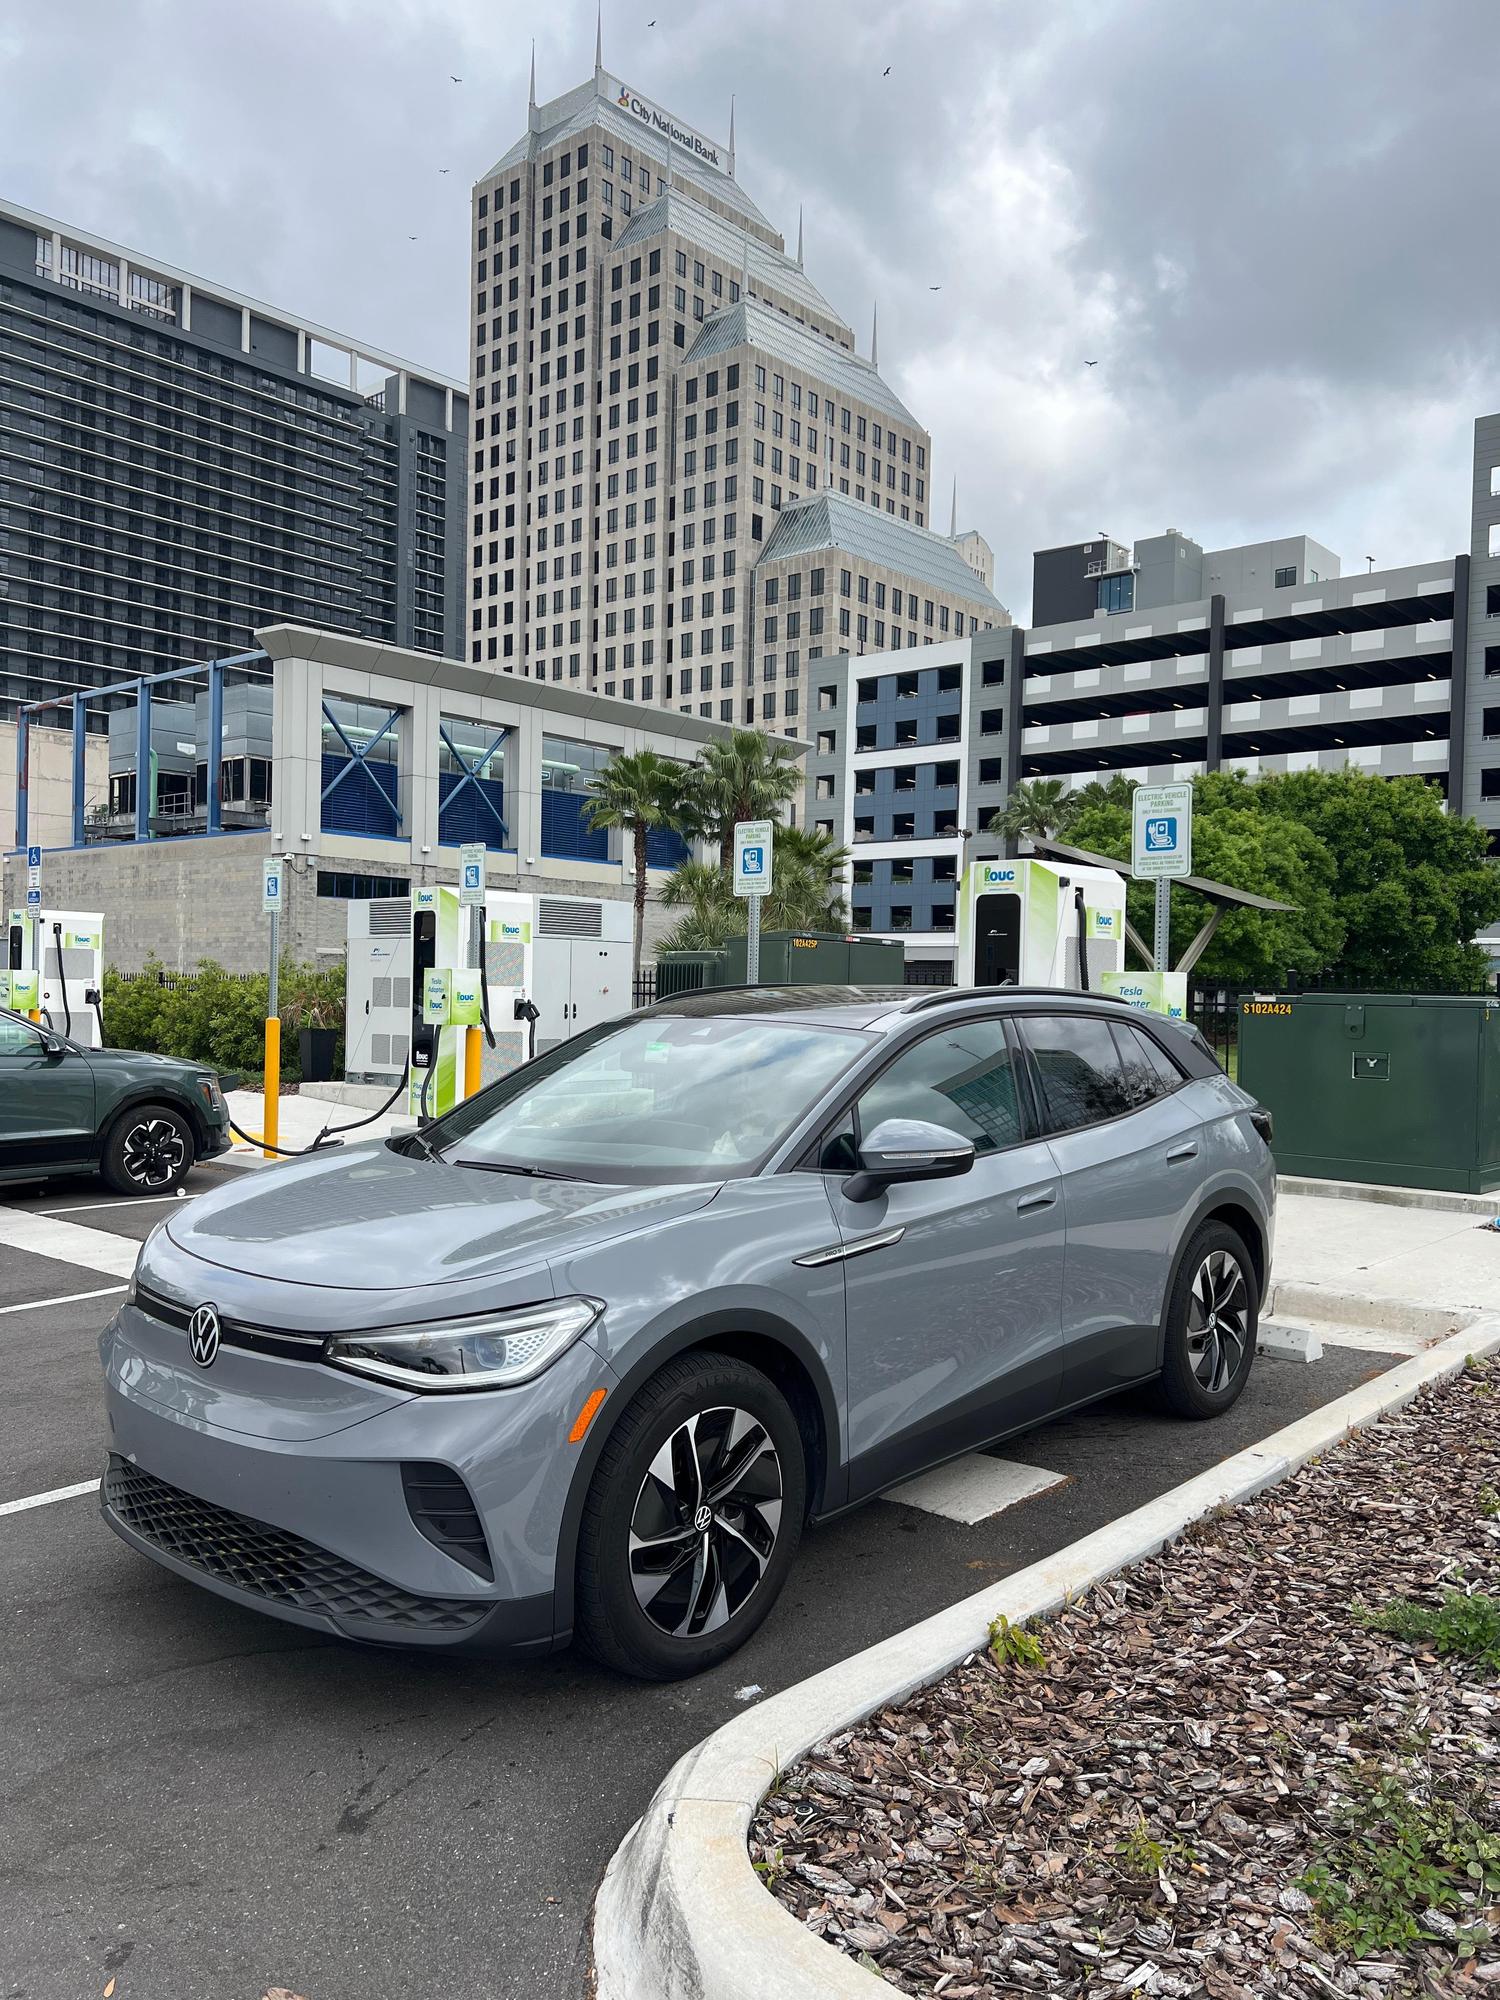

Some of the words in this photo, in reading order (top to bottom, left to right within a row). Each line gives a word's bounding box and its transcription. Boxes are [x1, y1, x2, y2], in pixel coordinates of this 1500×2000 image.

[631, 98, 651, 124] City
[652, 111, 694, 150] National
[694, 138, 719, 166] Bank
[1137, 793, 1163, 802] ELECTRIC
[1164, 790, 1188, 799] VEHICLE
[1150, 800, 1174, 808] PARKING
[1119, 986, 1143, 996] Tesla
[1243, 1003, 1292, 1015] S102A424
